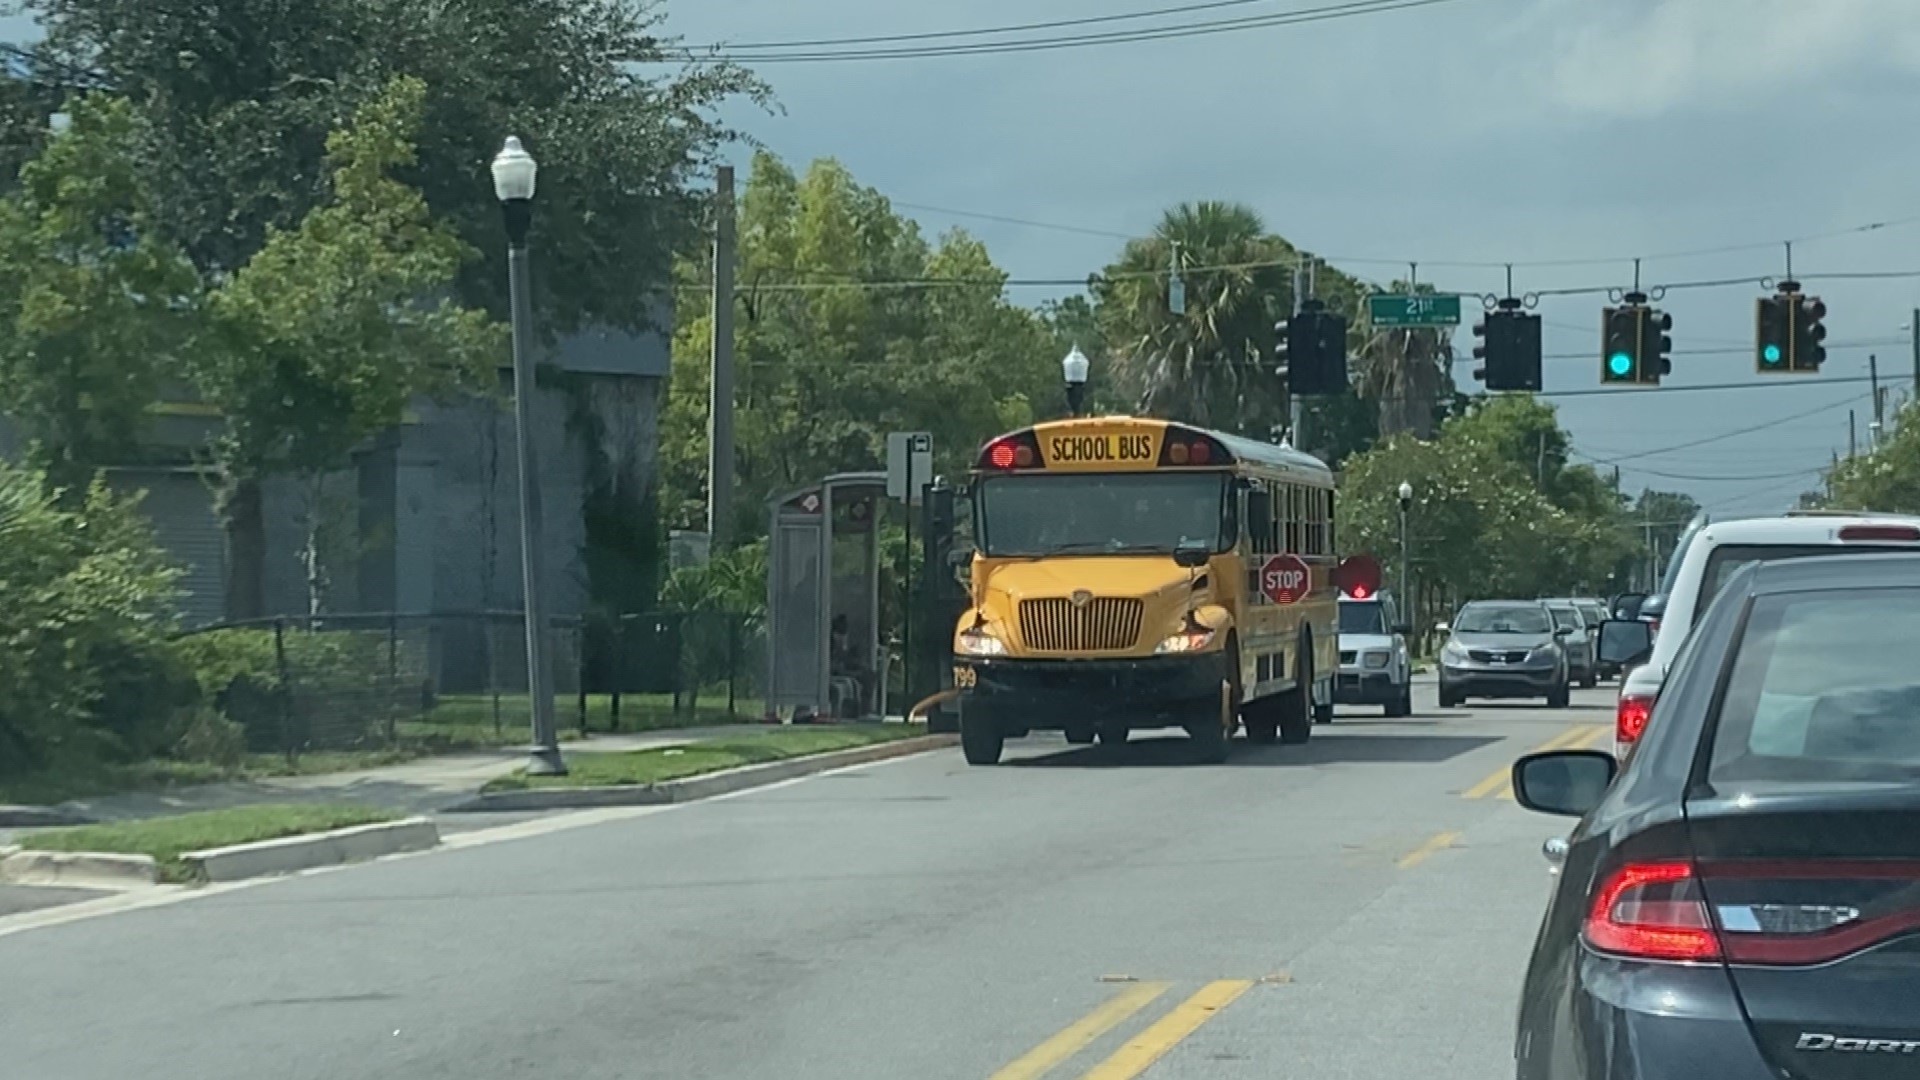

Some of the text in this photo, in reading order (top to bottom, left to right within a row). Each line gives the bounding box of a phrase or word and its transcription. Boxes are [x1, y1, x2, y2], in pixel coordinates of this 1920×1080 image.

[1052, 435, 1151, 461] SCHOOL BUS
[1266, 571, 1304, 589] STOP
